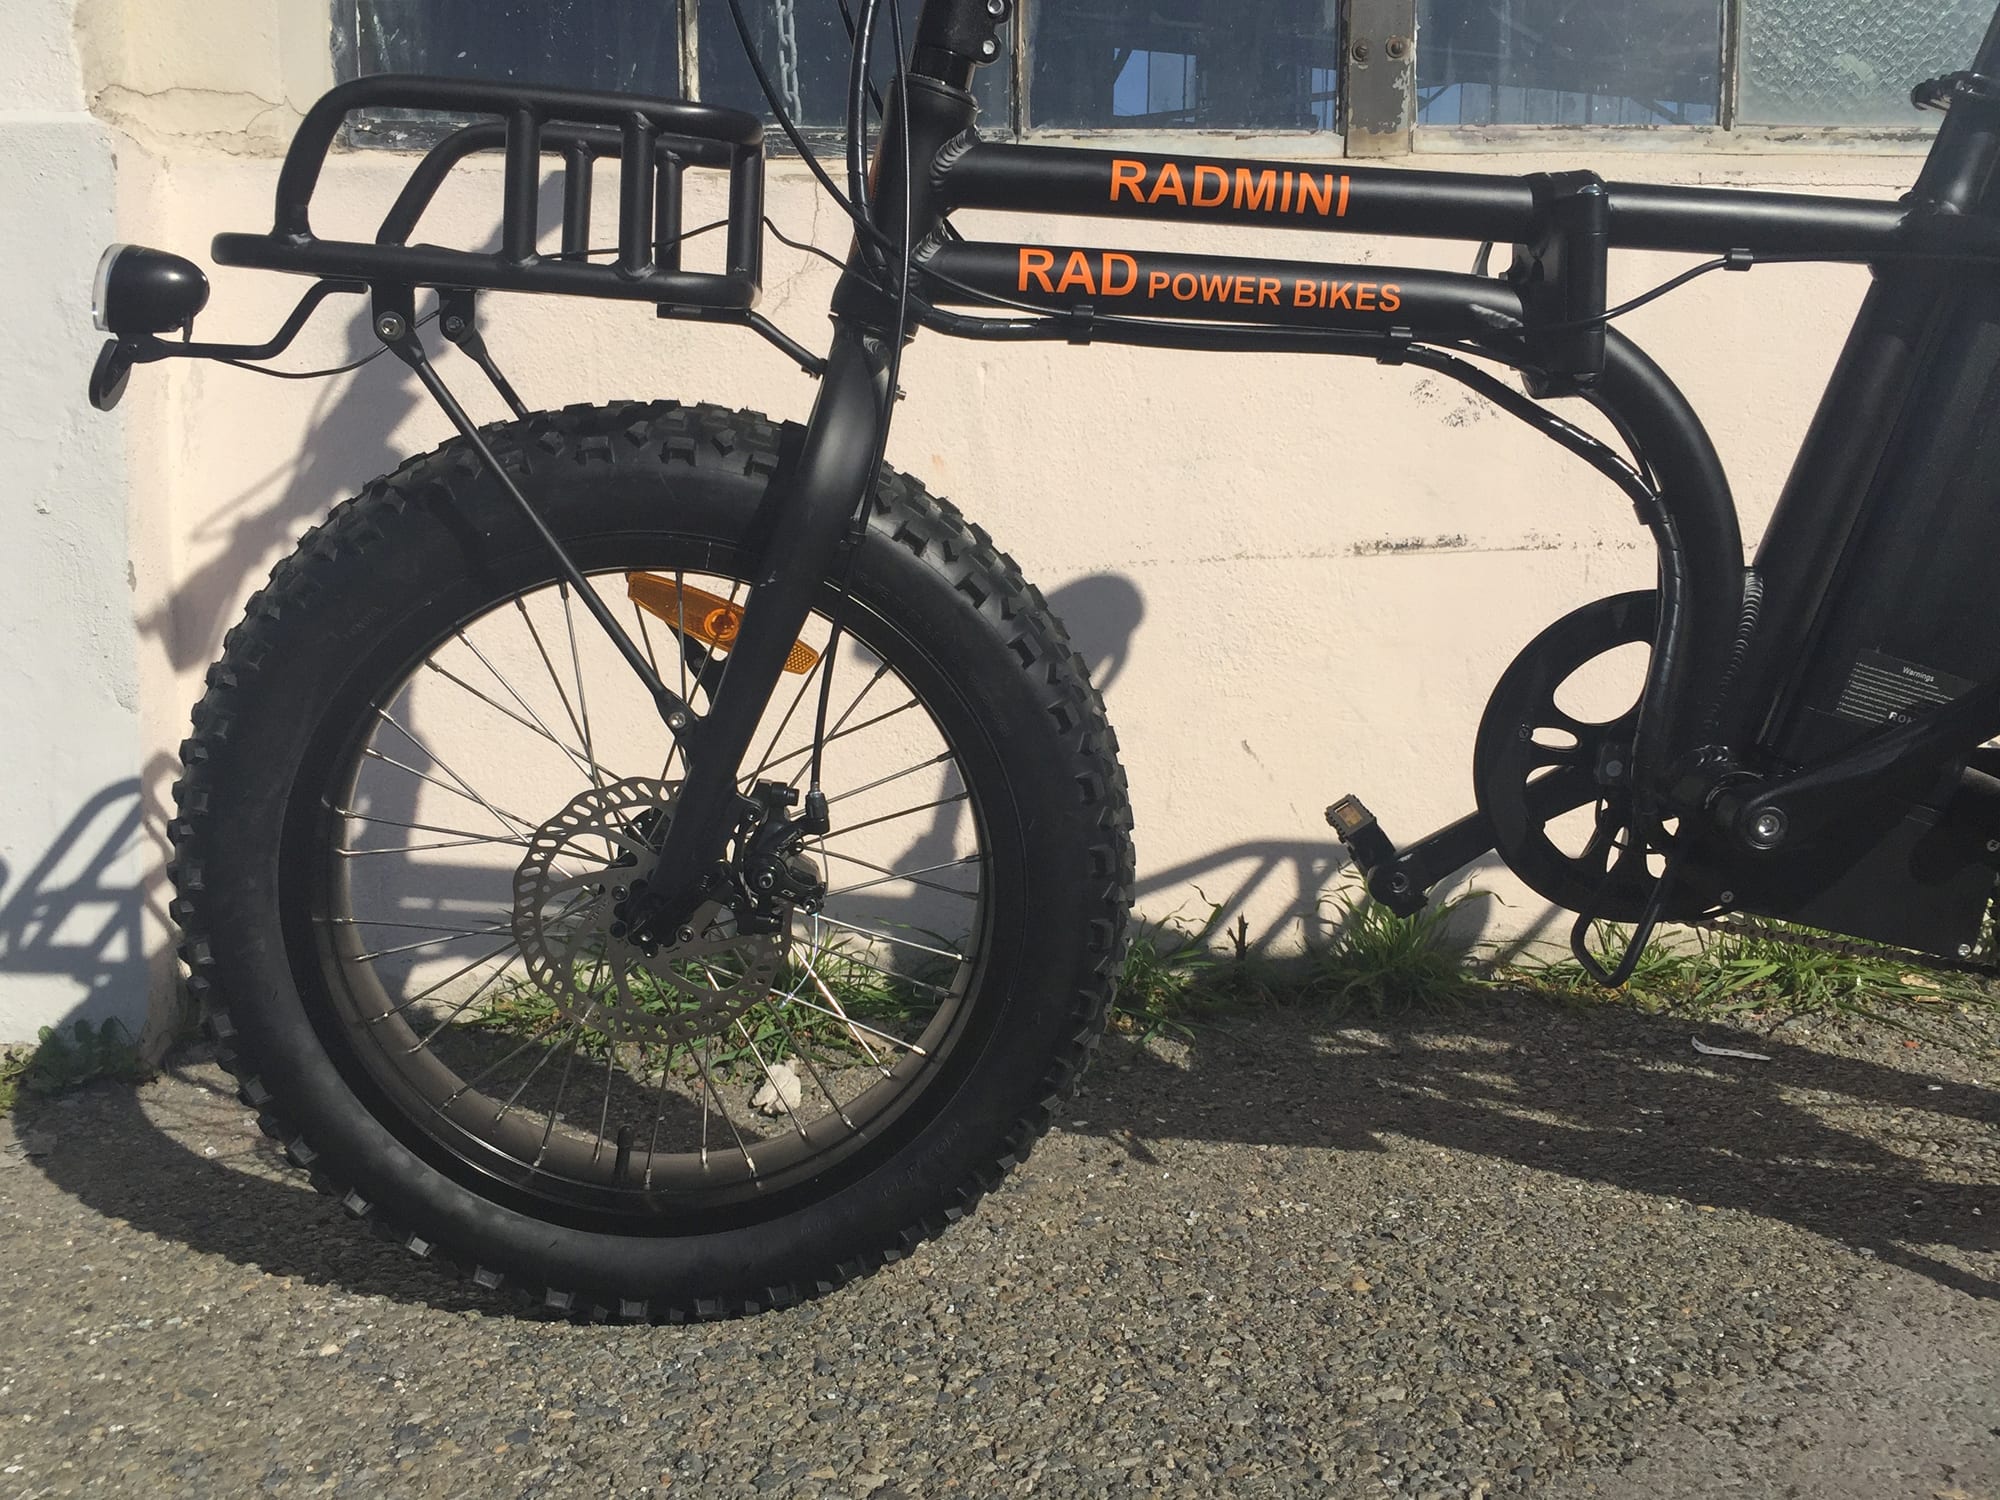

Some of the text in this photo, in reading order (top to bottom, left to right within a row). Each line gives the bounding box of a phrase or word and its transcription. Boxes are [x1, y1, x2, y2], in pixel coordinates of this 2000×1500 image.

[1110, 160, 1350, 216] RADMINI
[1018, 248, 1401, 312] RAD POWER BIKES
[1902, 666, 1935, 682] Warnings
